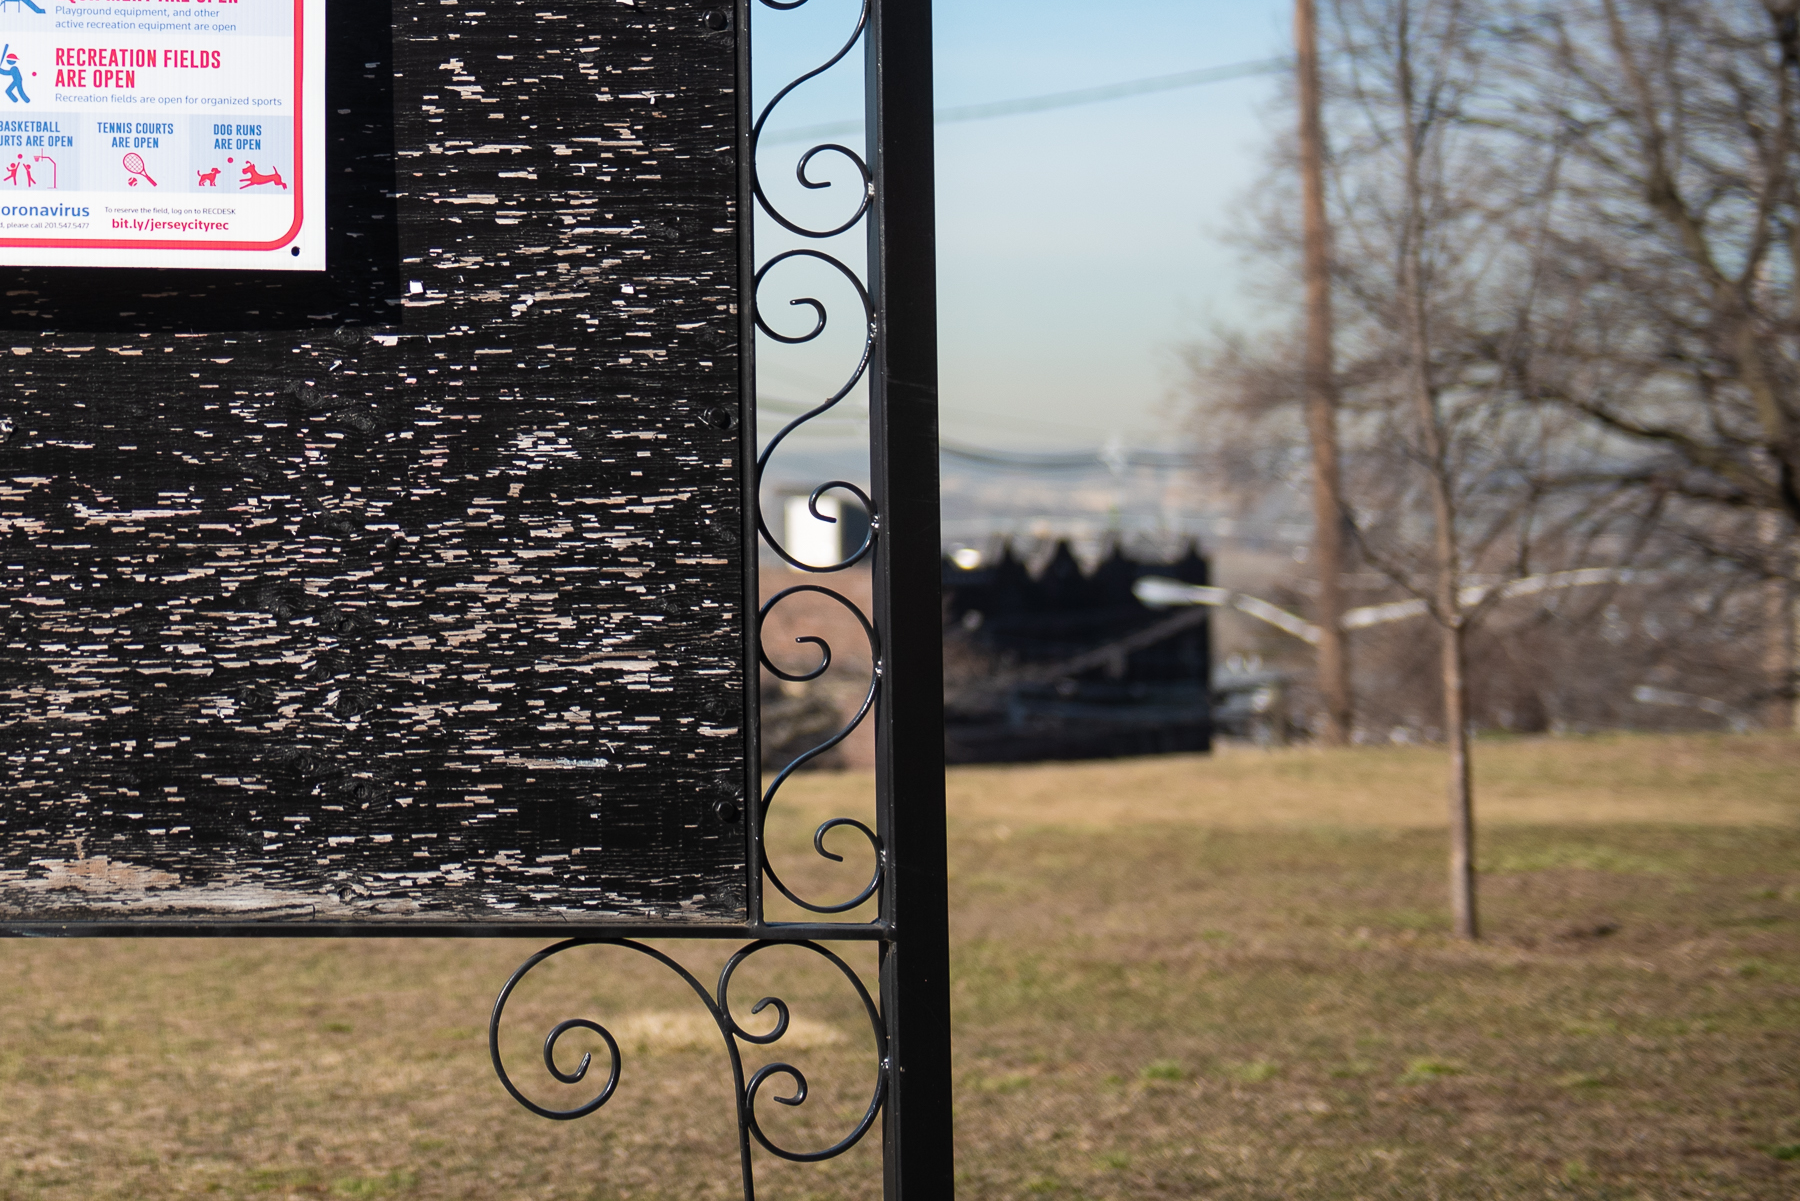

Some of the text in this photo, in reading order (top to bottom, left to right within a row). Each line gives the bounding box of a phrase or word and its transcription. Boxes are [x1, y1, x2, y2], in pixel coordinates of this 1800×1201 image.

[55, 5, 220, 18] Playground equipment, and other
[55, 19, 84, 28] active
[86, 20, 136, 29] recreation
[138, 21, 191, 32] equipment
[212, 24, 237, 32] open
[56, 47, 221, 68] RECREATION FIELDS
[55, 69, 135, 88] ARE OPEN
[55, 93, 108, 102] Recreation
[110, 94, 138, 103] fields
[158, 97, 183, 105] open
[185, 95, 199, 104] for
[200, 95, 249, 107] organized
[252, 97, 282, 107] sports
[97, 122, 174, 134] TENNIS COURTS
[213, 123, 262, 136] DOG RUNS
[25, 135, 45, 147] ARE
[48, 135, 73, 147] OPEN
[111, 136, 159, 148] ARE OPEN
[214, 138, 261, 150] ARE OPEN
[152, 207, 170, 215] field,
[171, 208, 183, 216] log
[202, 207, 236, 215] RECDESK
[6, 222, 29, 230] please
[44, 222, 90, 230] 201.547.5477
[112, 217, 229, 233] bit.ly/jerseycityrec
